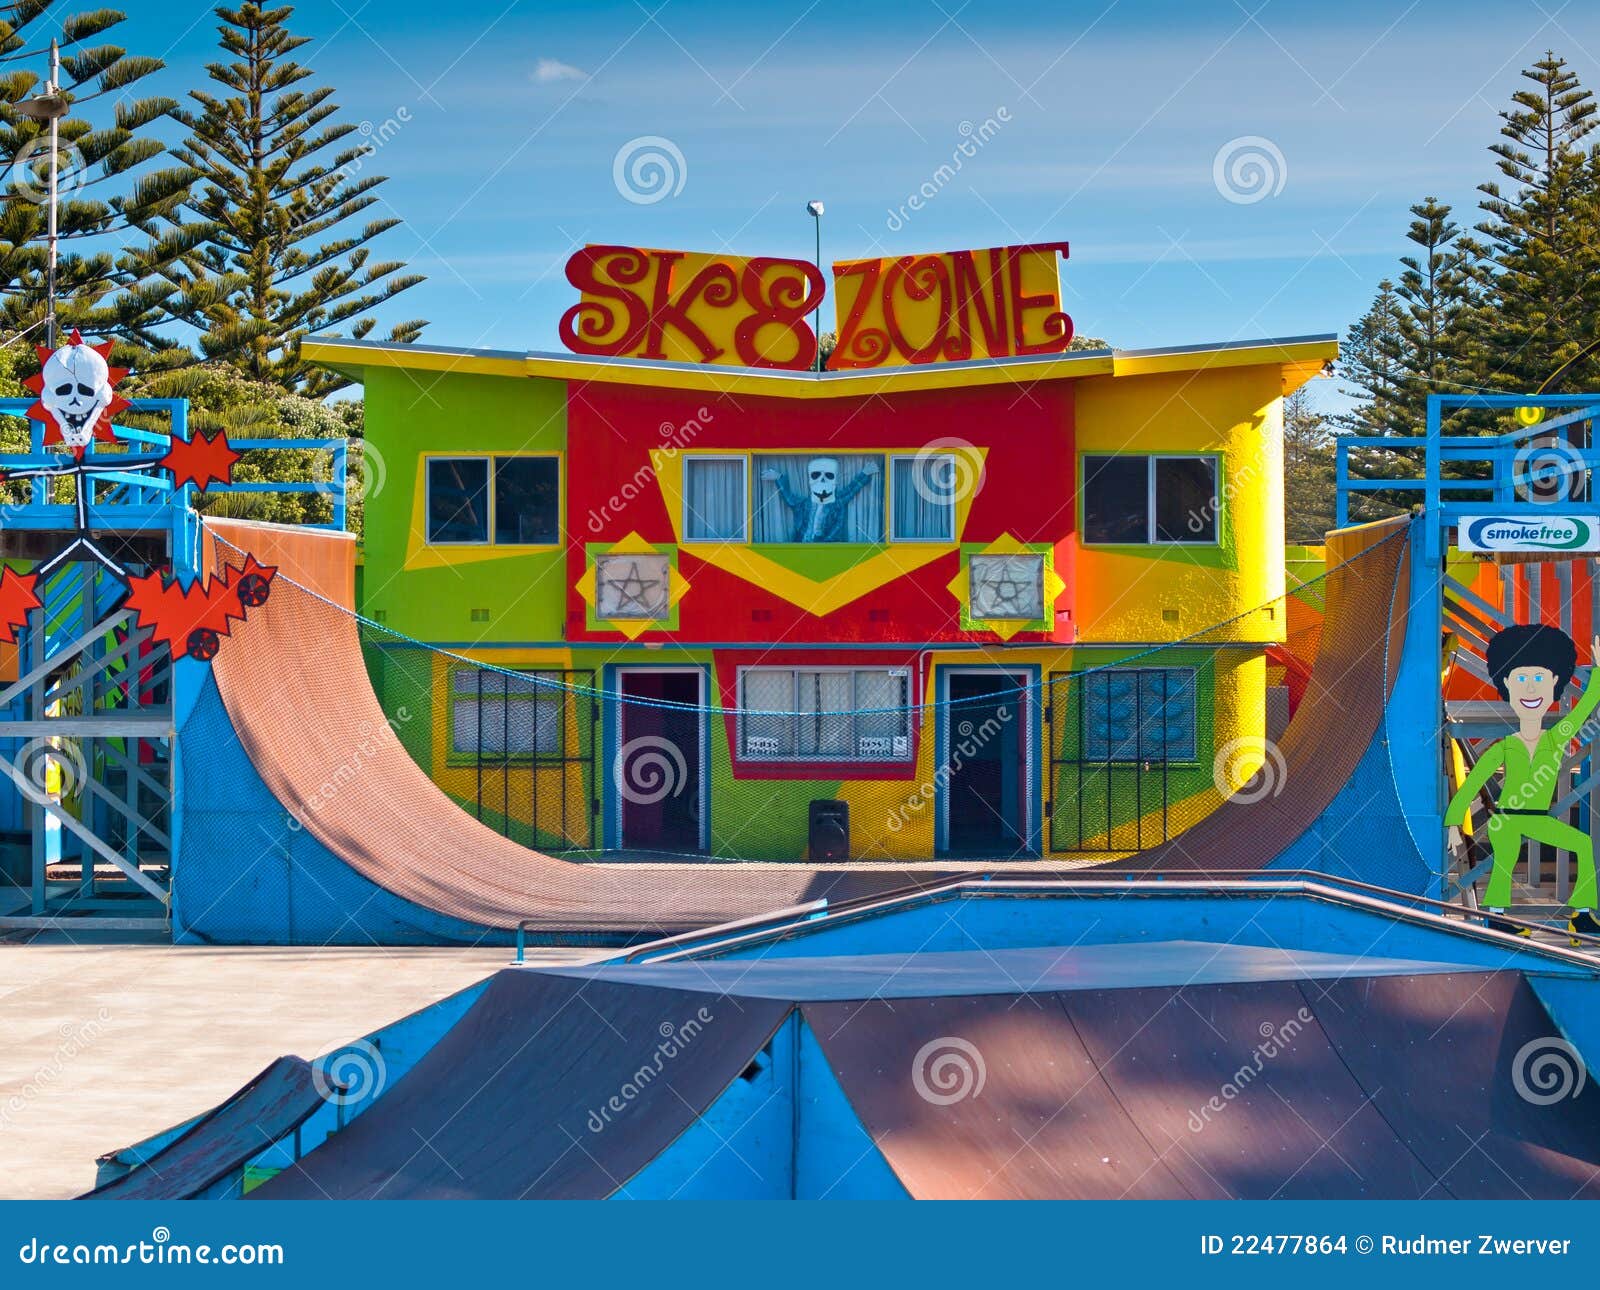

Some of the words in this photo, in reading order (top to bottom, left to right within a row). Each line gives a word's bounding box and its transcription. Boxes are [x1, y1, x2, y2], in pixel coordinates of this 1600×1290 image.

[558, 243, 826, 371] SK8
[825, 241, 1074, 370] ZONE
[1486, 526, 1573, 540] smokefree
